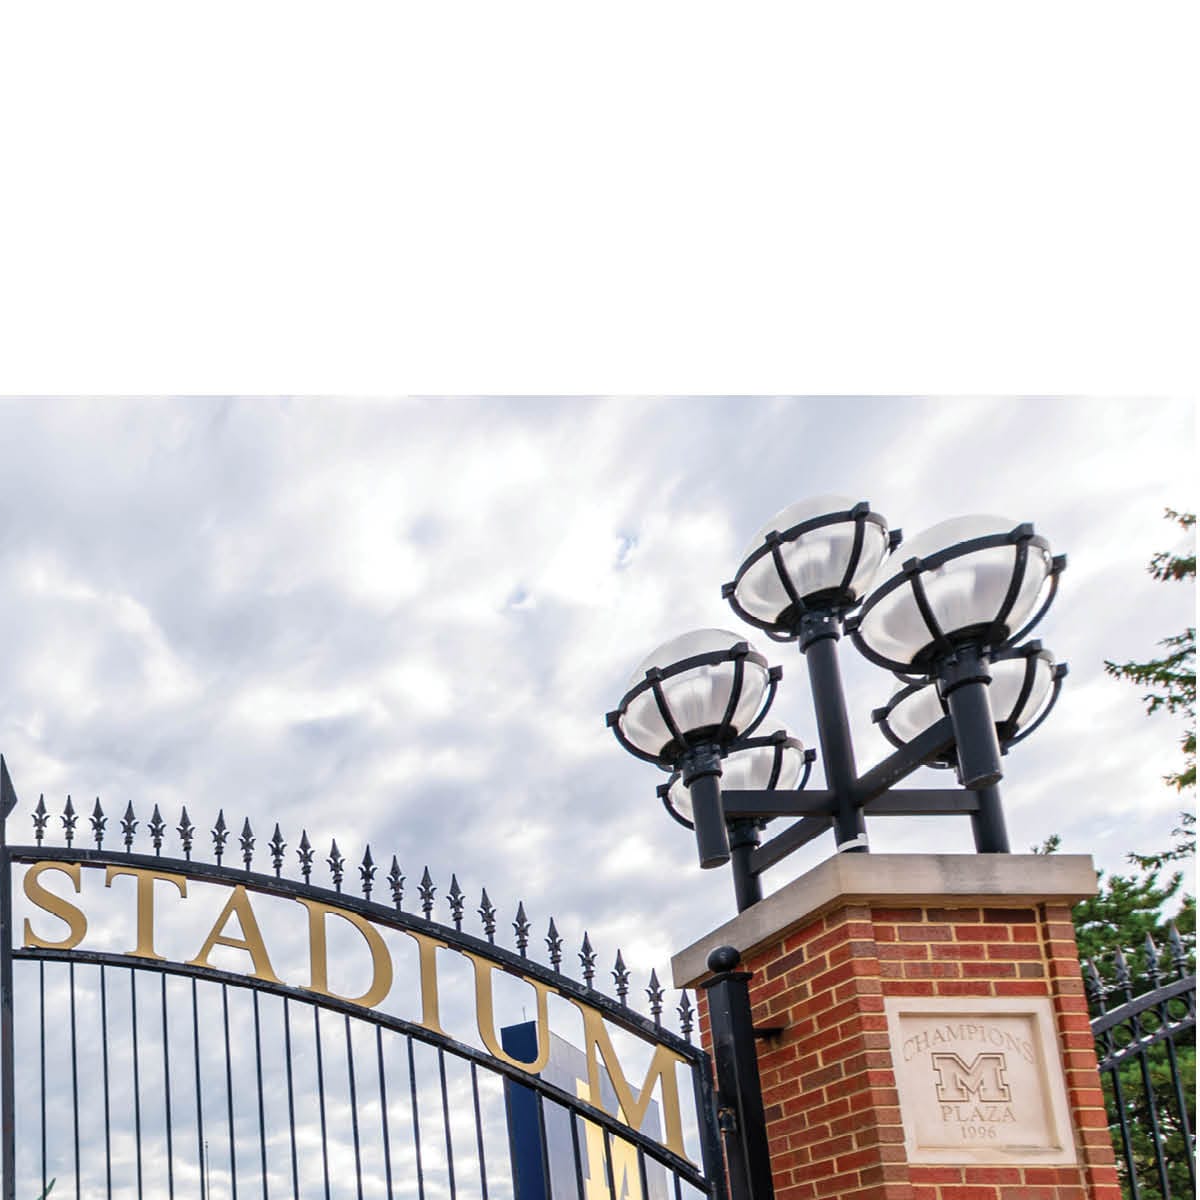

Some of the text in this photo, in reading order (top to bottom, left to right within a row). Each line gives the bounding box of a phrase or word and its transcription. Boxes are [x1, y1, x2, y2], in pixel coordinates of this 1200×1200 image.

[22, 860, 702, 1174] STADIUM
[903, 1023, 1035, 1065] CHAMPIONS
[931, 1052, 1012, 1102] M
[941, 1105, 1016, 1122] PLAZA
[962, 1126, 997, 1140] 1996
